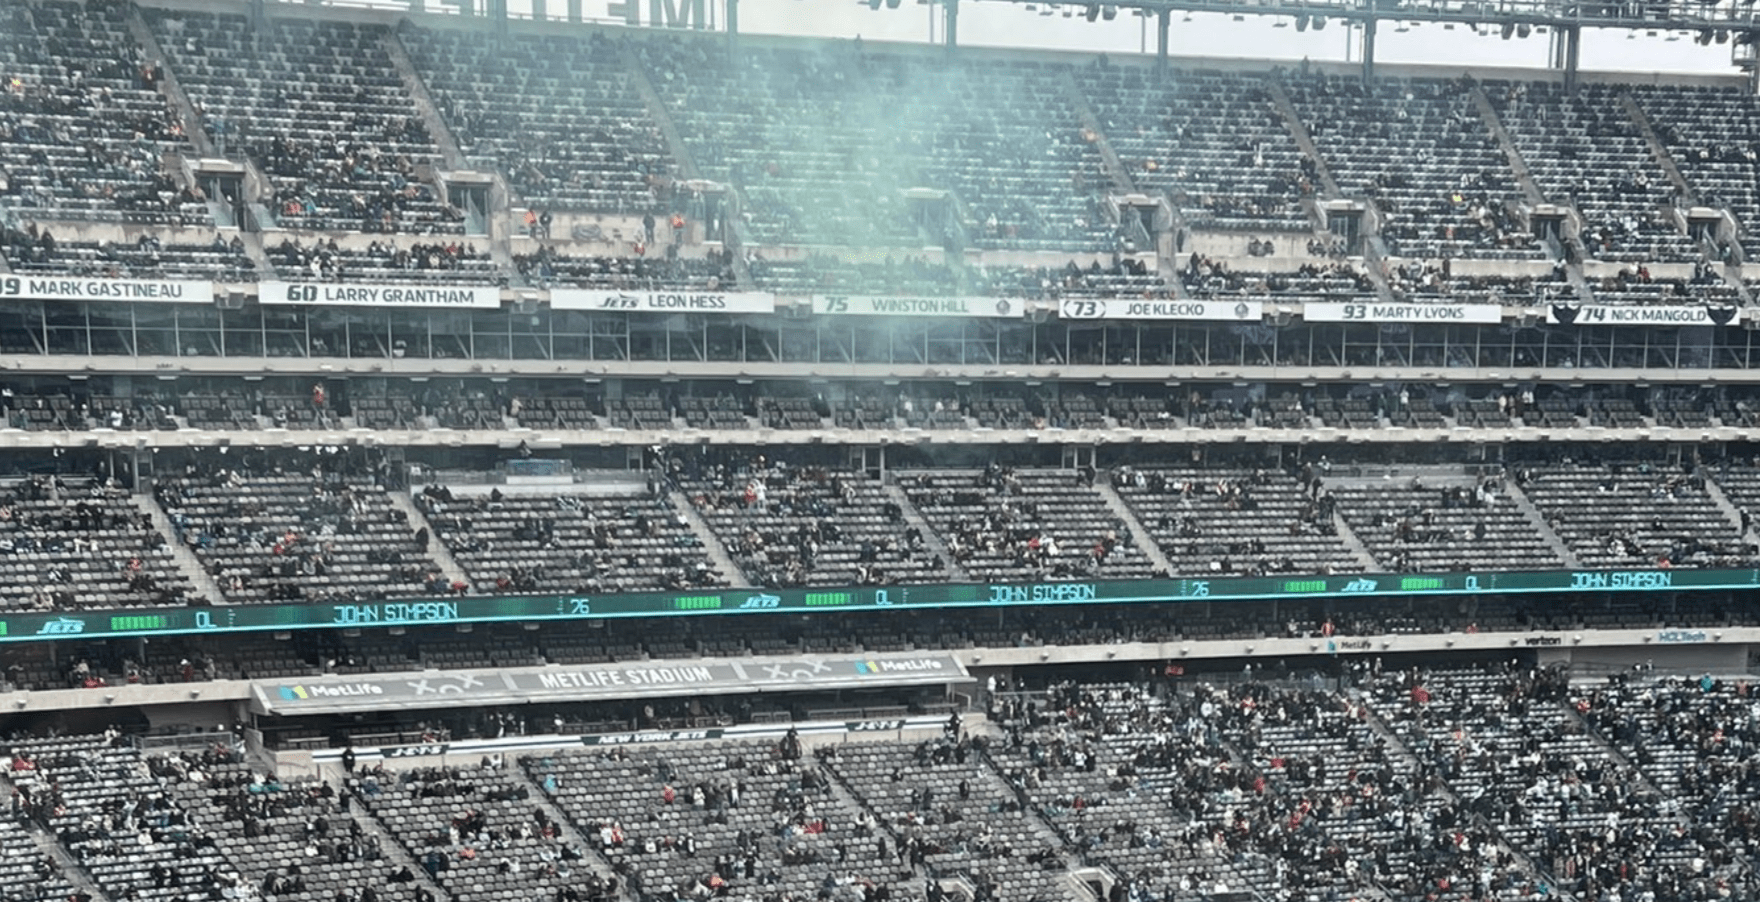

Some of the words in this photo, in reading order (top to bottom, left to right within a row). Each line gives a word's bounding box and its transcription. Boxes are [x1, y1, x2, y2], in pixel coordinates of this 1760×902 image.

[30, 280, 82, 296] MARK
[87, 281, 182, 298] GASTINEAU
[287, 284, 318, 302] 60
[325, 287, 379, 302] LARRY
[383, 288, 475, 304] GRANTHAM
[597, 293, 640, 308] JETS
[648, 294, 687, 308] LEON
[690, 295, 726, 309] HESS
[825, 296, 848, 312] 75
[871, 298, 939, 313] WINSTON
[942, 300, 970, 314] HILL
[1126, 302, 1150, 316] JOE
[1153, 302, 1205, 316] KLECKO
[1342, 305, 1367, 319] 93
[1373, 306, 1422, 319] MARTY
[1424, 306, 1465, 319] LYONS
[1583, 308, 1607, 321] 74
[1611, 308, 1638, 321] NICK
[1641, 309, 1707, 322] MANGOLD
[1571, 572, 1608, 588] JOHN
[1611, 571, 1672, 587] SIMPSON
[740, 592, 781, 608] JETS
[990, 586, 1028, 602] JOHN
[1033, 584, 1096, 600] SIMPSON
[333, 605, 378, 623] JOHN
[385, 602, 457, 622] SIMPSON
[880, 659, 943, 672] MetLife
[538, 670, 625, 689] METLIFE
[624, 666, 713, 684] STADIUM
[309, 683, 383, 697] MetLife
[598, 735, 632, 745] NEW
[634, 732, 673, 742] YORK
[673, 730, 708, 741] JETS
